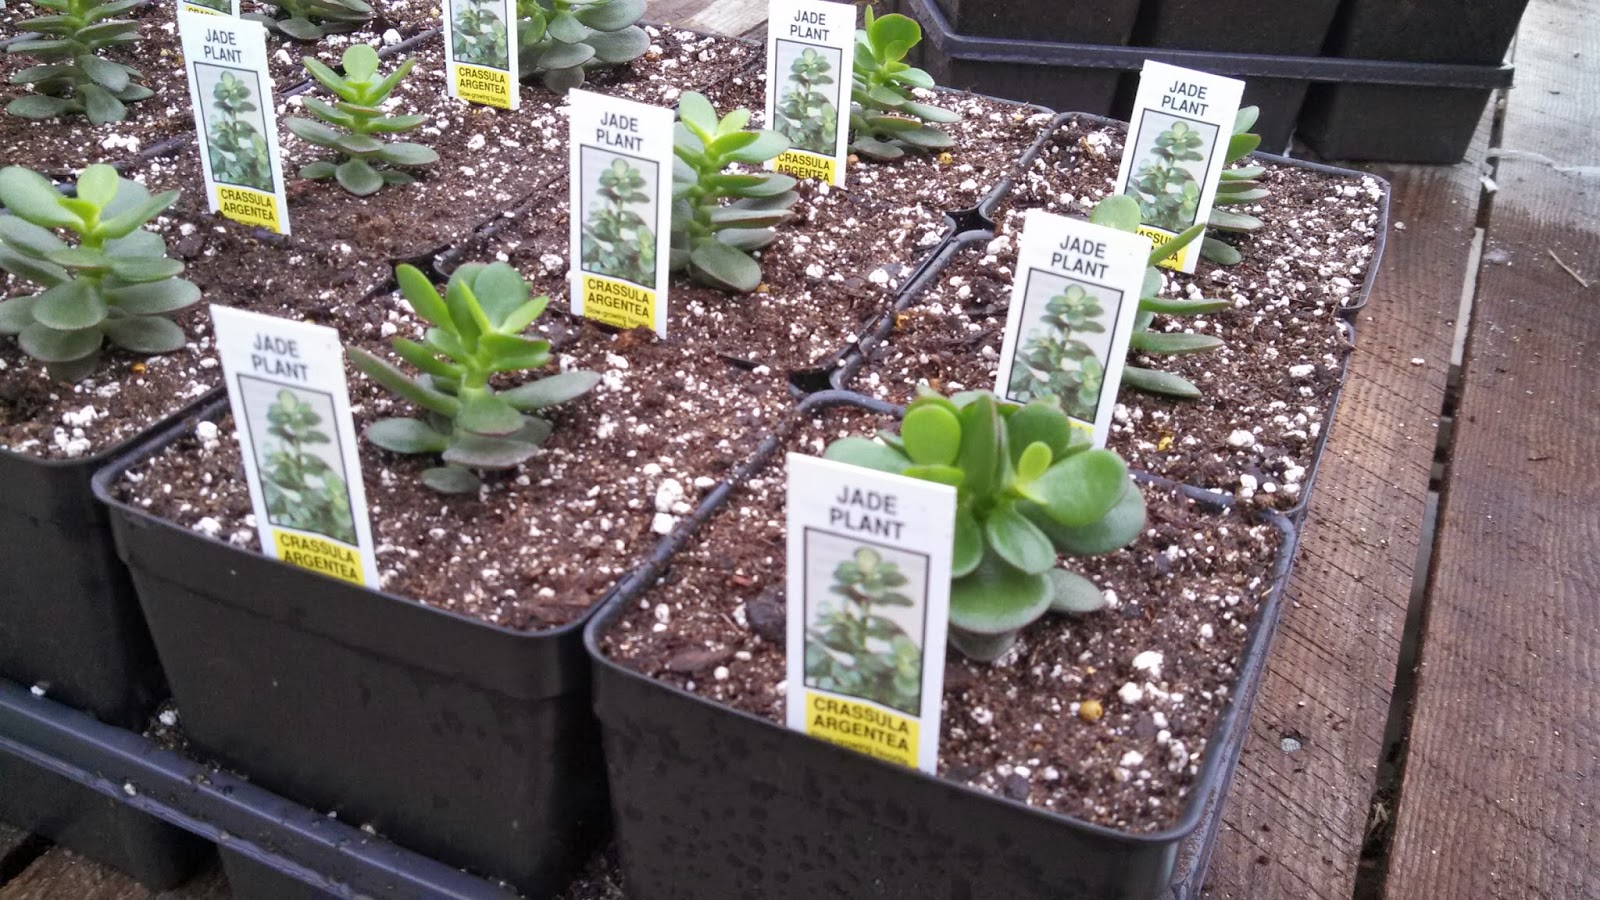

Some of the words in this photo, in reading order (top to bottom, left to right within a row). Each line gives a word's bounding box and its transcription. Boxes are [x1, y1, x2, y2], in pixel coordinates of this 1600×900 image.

[794, 10, 826, 25] JADE
[205, 29, 236, 45] JADE
[790, 24, 829, 41] PLANT
[204, 45, 242, 63] PLANT
[459, 67, 505, 84] CRASSULA
[460, 79, 506, 95] ARGENTEA
[1169, 81, 1208, 100] JADE
[1161, 95, 1208, 116] PLANT
[600, 112, 638, 132] JADE
[596, 128, 643, 151] PLANT
[778, 153, 830, 170] CRASSULA
[221, 189, 273, 208] CRASSULA
[223, 202, 275, 221] ARGENTEA
[1060, 235, 1107, 259] JADE
[1051, 252, 1109, 279] PLANT
[588, 279, 649, 304] CRASSULA
[588, 293, 649, 318] ARGENTEA
[253, 332, 299, 358] JADE
[251, 353, 307, 381] PLANT
[836, 485, 898, 515] JADE
[829, 507, 904, 540] PLANT
[280, 533, 355, 565] CRASSULA
[284, 550, 358, 581] ARGENTEA
[814, 697, 909, 735] CRASSULA
[814, 715, 909, 752] ARGENTEA
